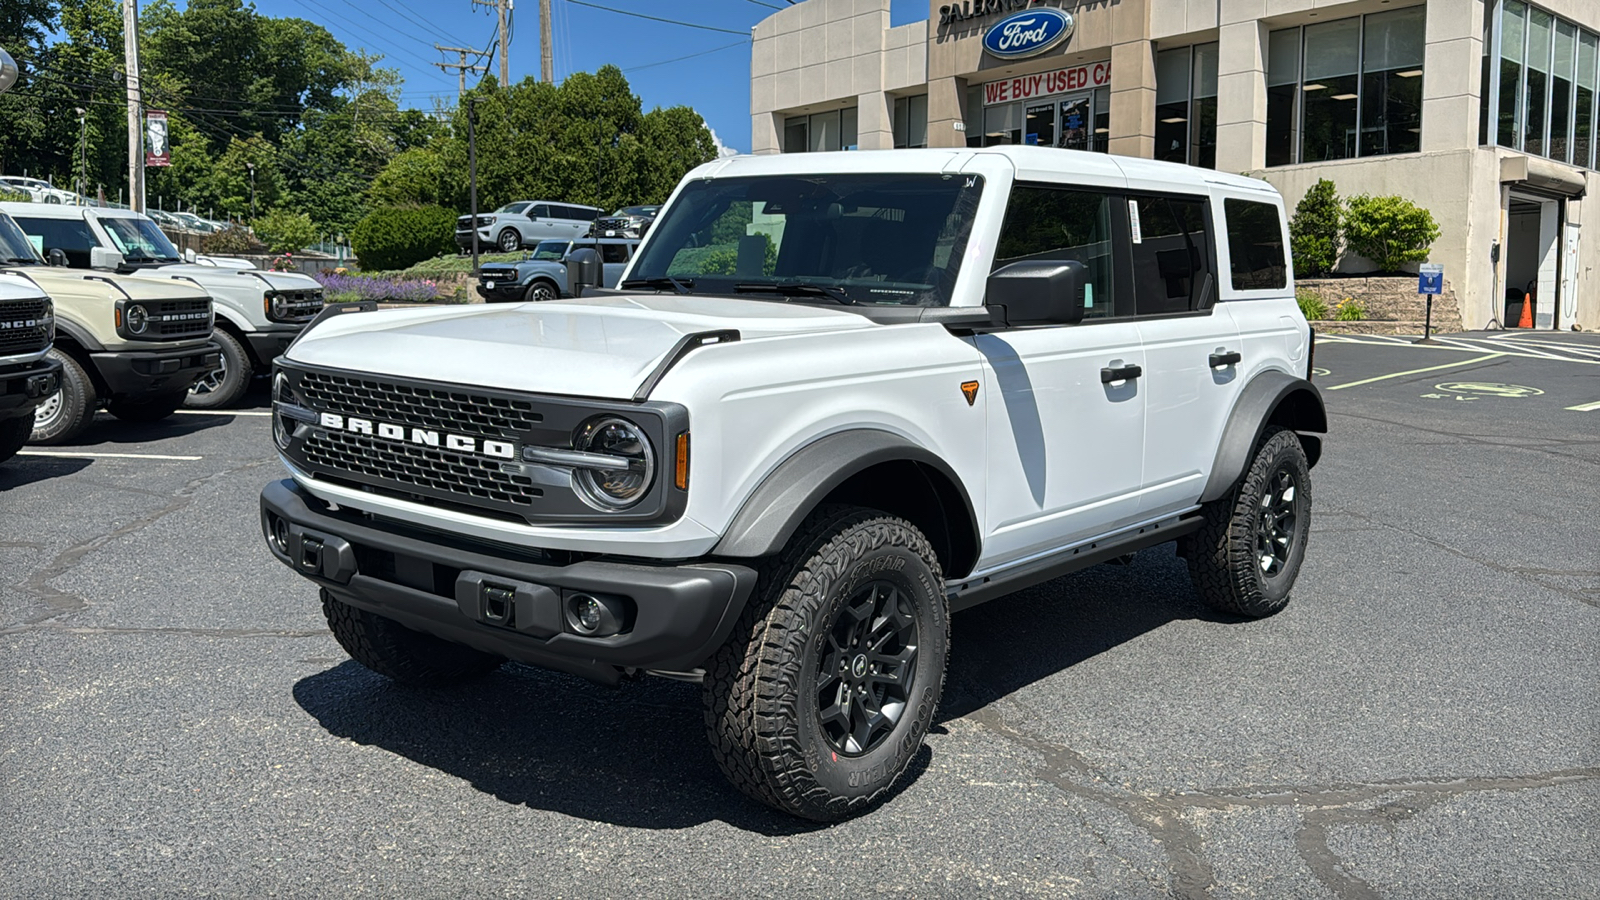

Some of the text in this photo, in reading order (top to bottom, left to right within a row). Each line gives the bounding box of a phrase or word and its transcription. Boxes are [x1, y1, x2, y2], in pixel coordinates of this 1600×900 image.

[999, 18, 1048, 50] Ford
[985, 81, 1008, 103] WE
[1012, 74, 1042, 99] BUY
[1046, 67, 1088, 93] USED
[965, 175, 978, 188] W
[162, 312, 208, 321] BRONCO
[320, 412, 515, 459] BRONCO
